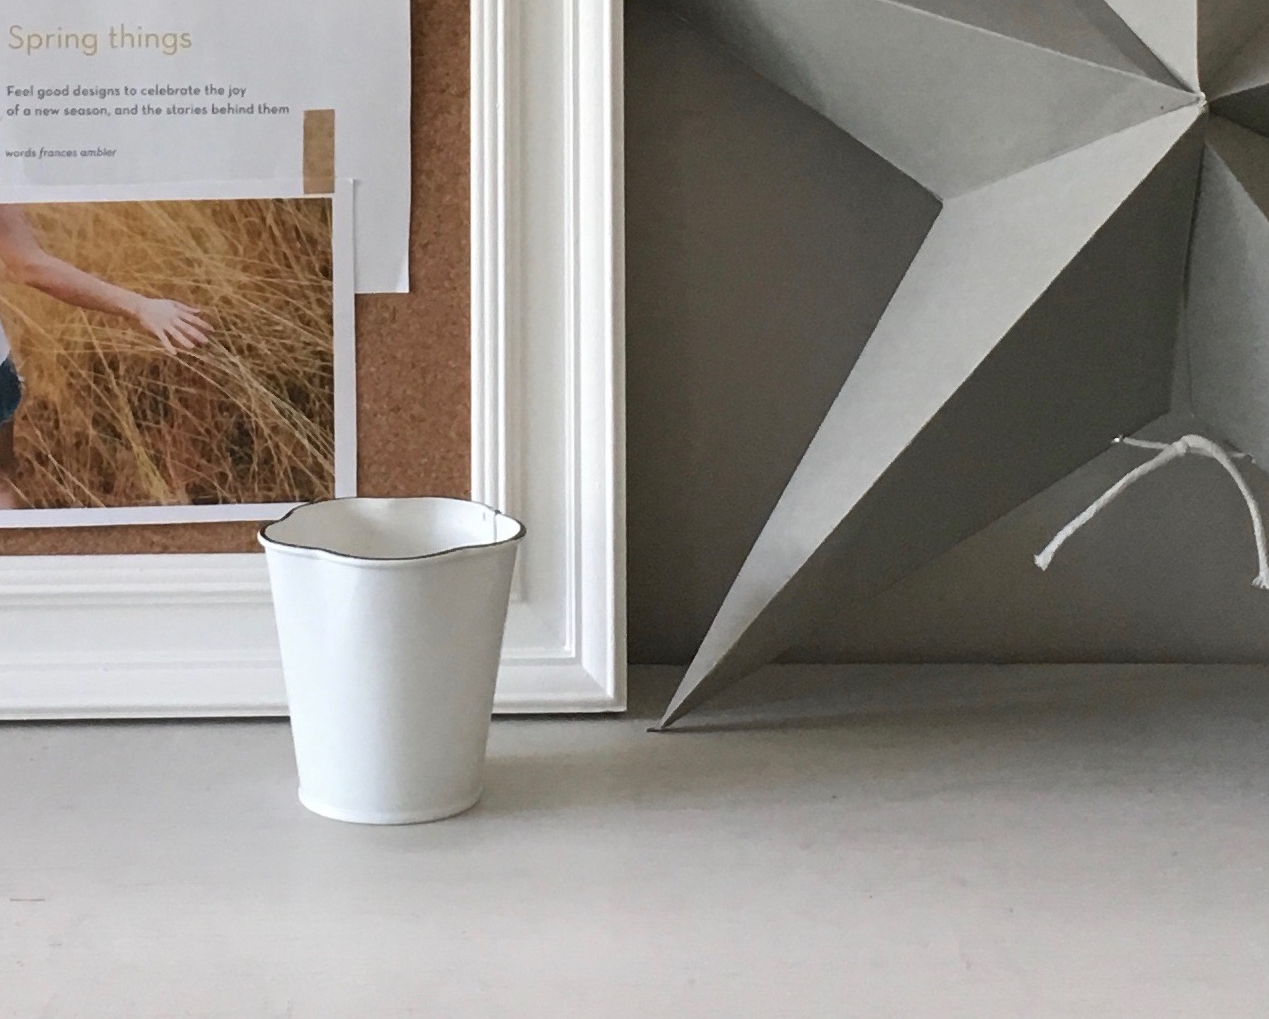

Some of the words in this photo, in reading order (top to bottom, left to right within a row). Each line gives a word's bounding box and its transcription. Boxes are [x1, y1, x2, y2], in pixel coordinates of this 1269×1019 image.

[7, 24, 98, 57] Spring
[108, 23, 193, 56] things
[6, 84, 34, 97] Feel
[37, 84, 70, 100] good
[73, 84, 121, 100] designs
[124, 85, 138, 96] to
[141, 83, 201, 96] celebrate
[204, 83, 225, 96] the
[227, 84, 247, 99] joy
[6, 103, 20, 117] of
[22, 107, 31, 117] a
[34, 107, 61, 117] new
[63, 107, 112, 117] season,
[114, 103, 138, 116] and
[142, 103, 162, 116] the
[166, 103, 208, 115] stories
[211, 102, 255, 115] behind
[258, 102, 290, 115] them
[5, 147, 37, 158] words
[38, 147, 78, 160] frances
